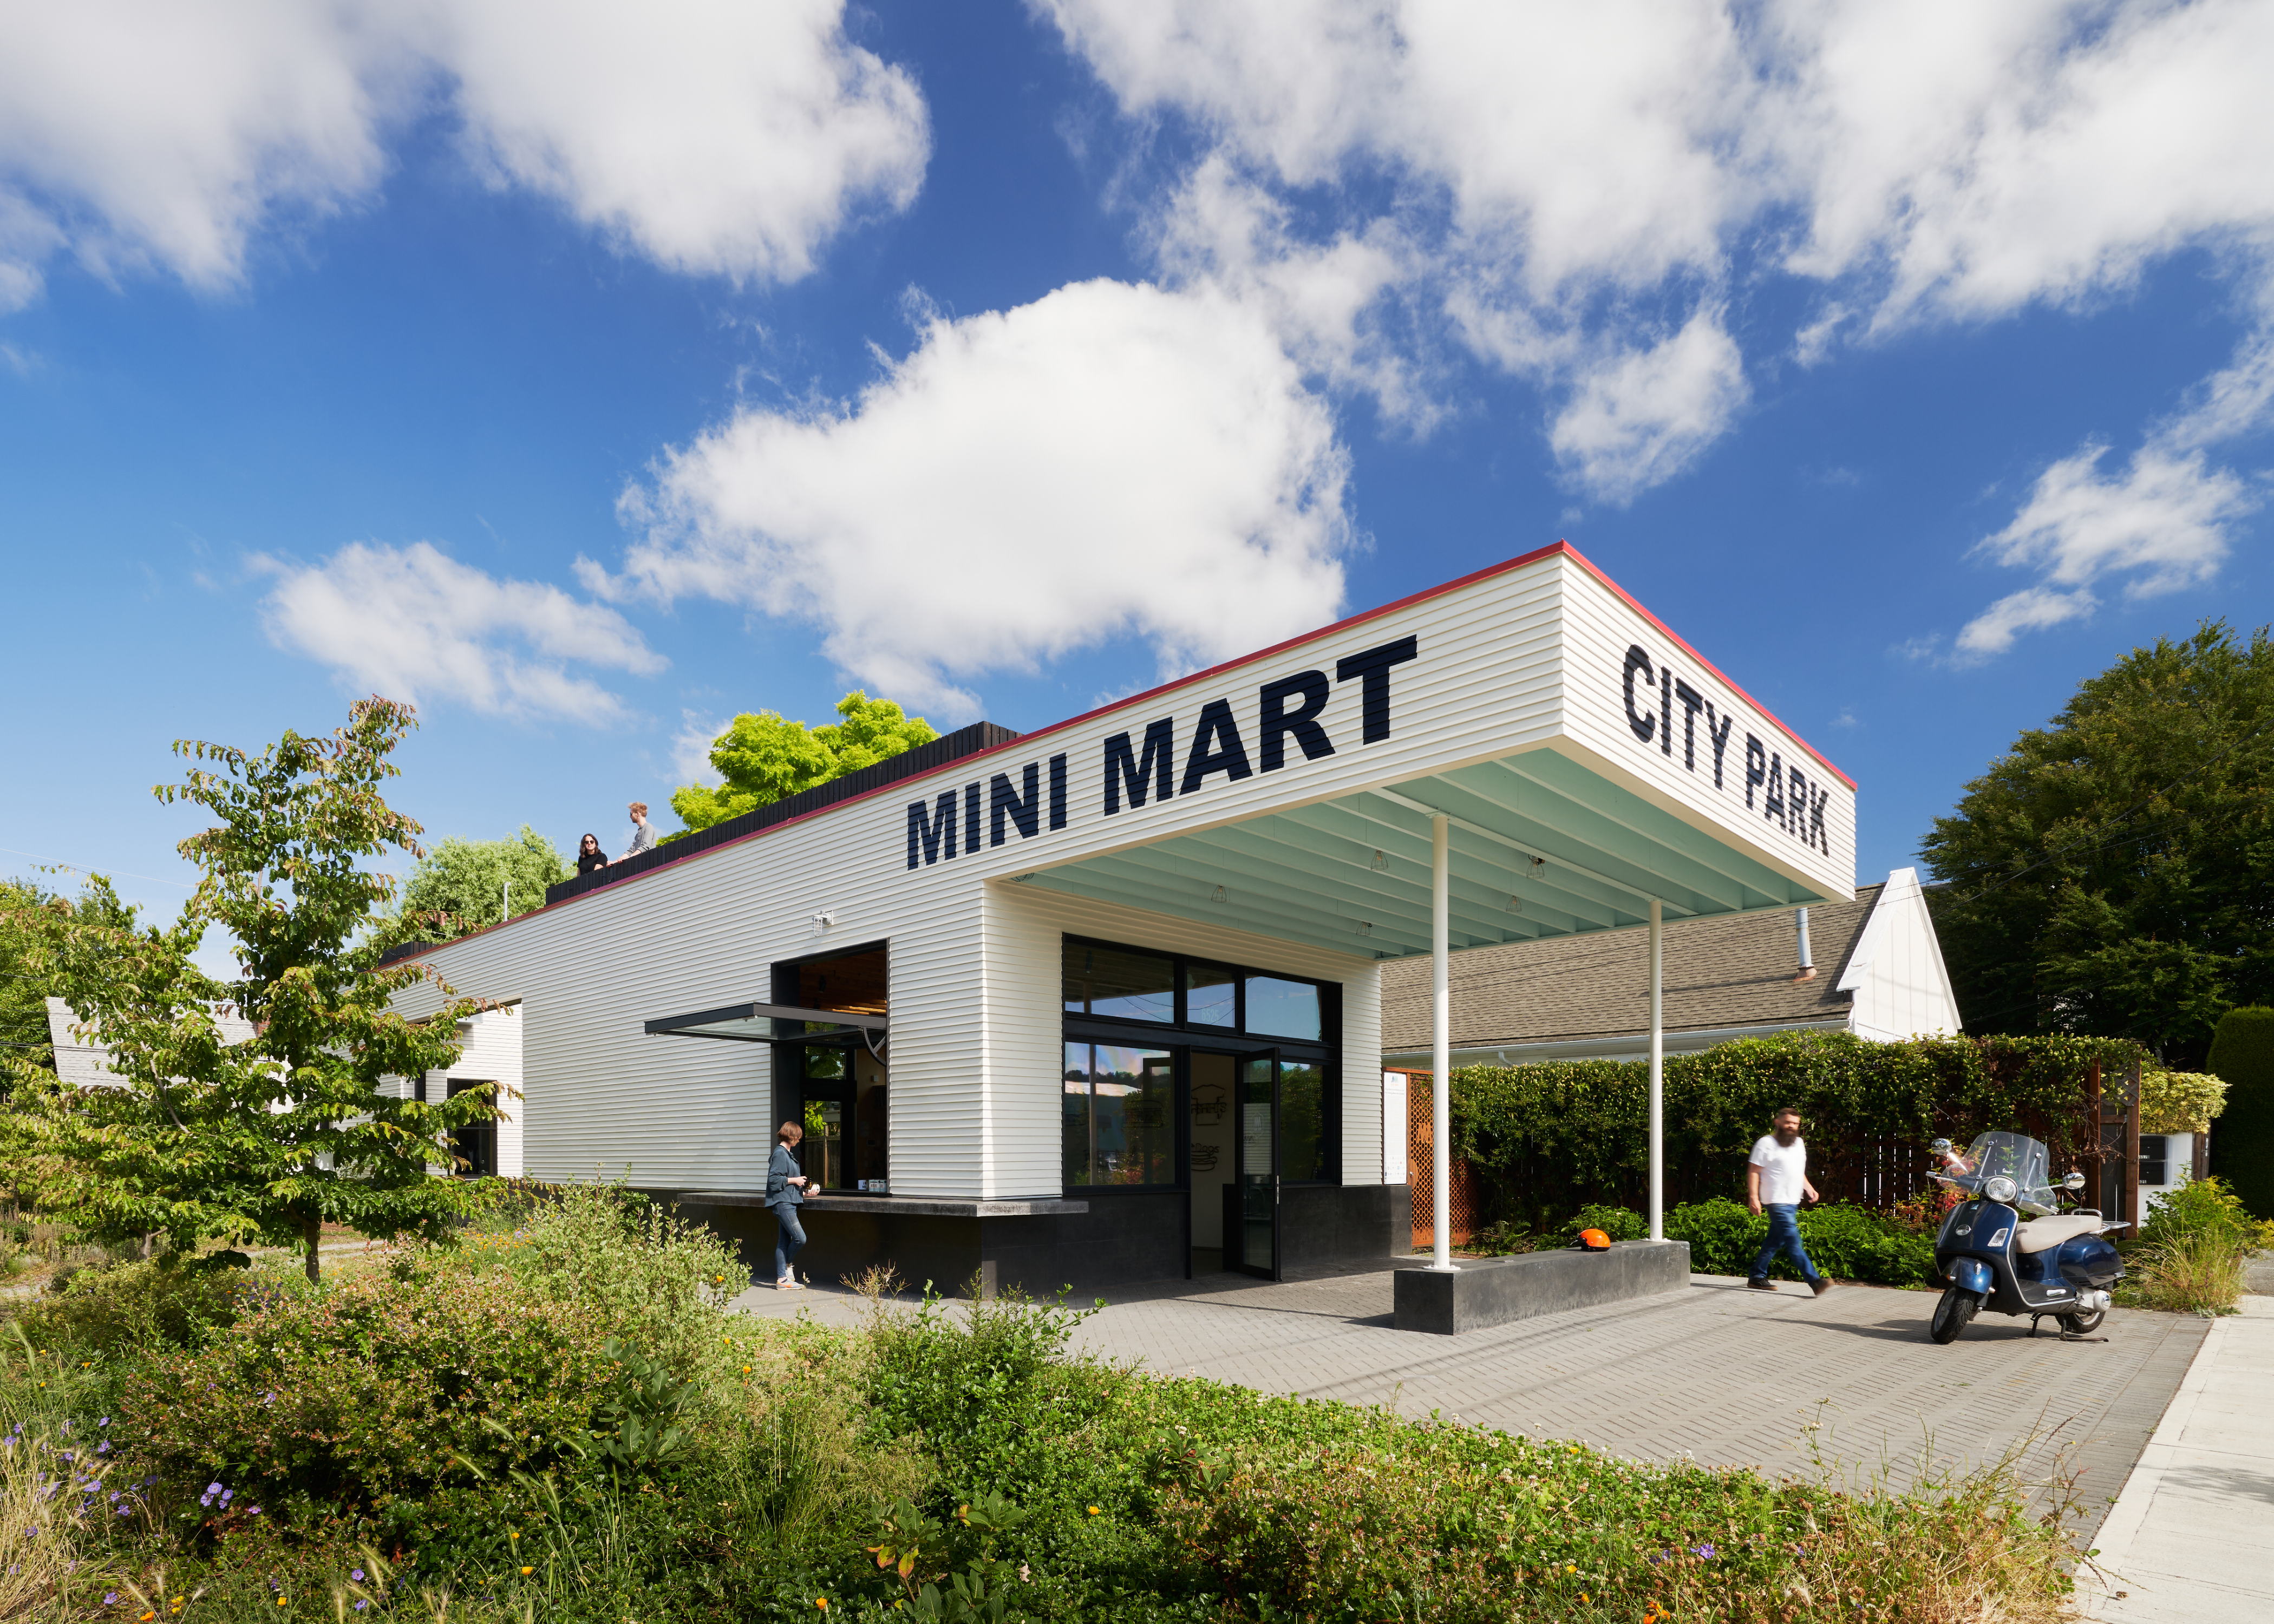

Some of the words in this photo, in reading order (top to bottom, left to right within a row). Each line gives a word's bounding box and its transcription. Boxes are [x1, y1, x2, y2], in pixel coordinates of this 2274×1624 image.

[907, 752, 1067, 871] MINI
[1103, 634, 1417, 816] MART
[1622, 644, 1733, 791] CITY
[1745, 731, 1829, 858] PARK
[1202, 1008, 1219, 1023] 6525
